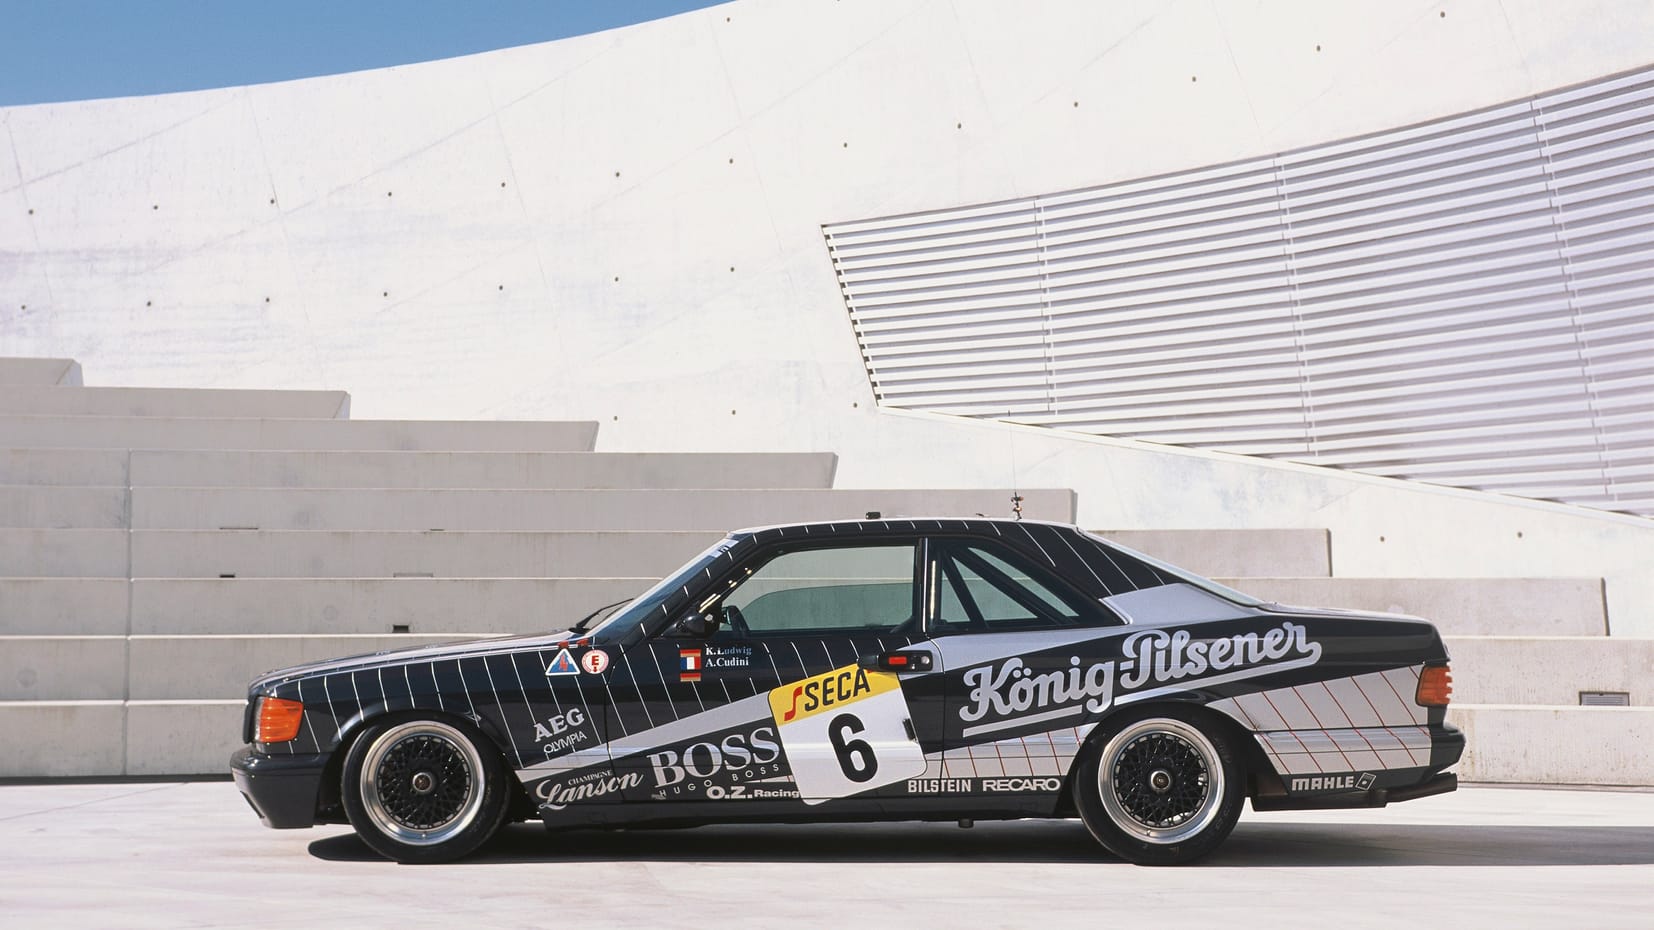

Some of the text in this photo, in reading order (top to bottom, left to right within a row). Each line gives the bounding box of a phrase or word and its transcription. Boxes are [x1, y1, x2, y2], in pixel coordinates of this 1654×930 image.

[804, 668, 871, 712] SECA
[533, 708, 585, 742] AEG
[543, 731, 588, 753] OLYMPIA
[646, 727, 780, 788] BOSS
[828, 713, 878, 782] 6
[536, 772, 644, 810] Lanson
[568, 770, 614, 786] CHAMPAGNE
[659, 764, 779, 797] HUGO BOSS
[754, 789, 800, 799] Racing
[908, 778, 1061, 793] BILSTEIN RECARO
[1291, 775, 1355, 791] MAHLE
